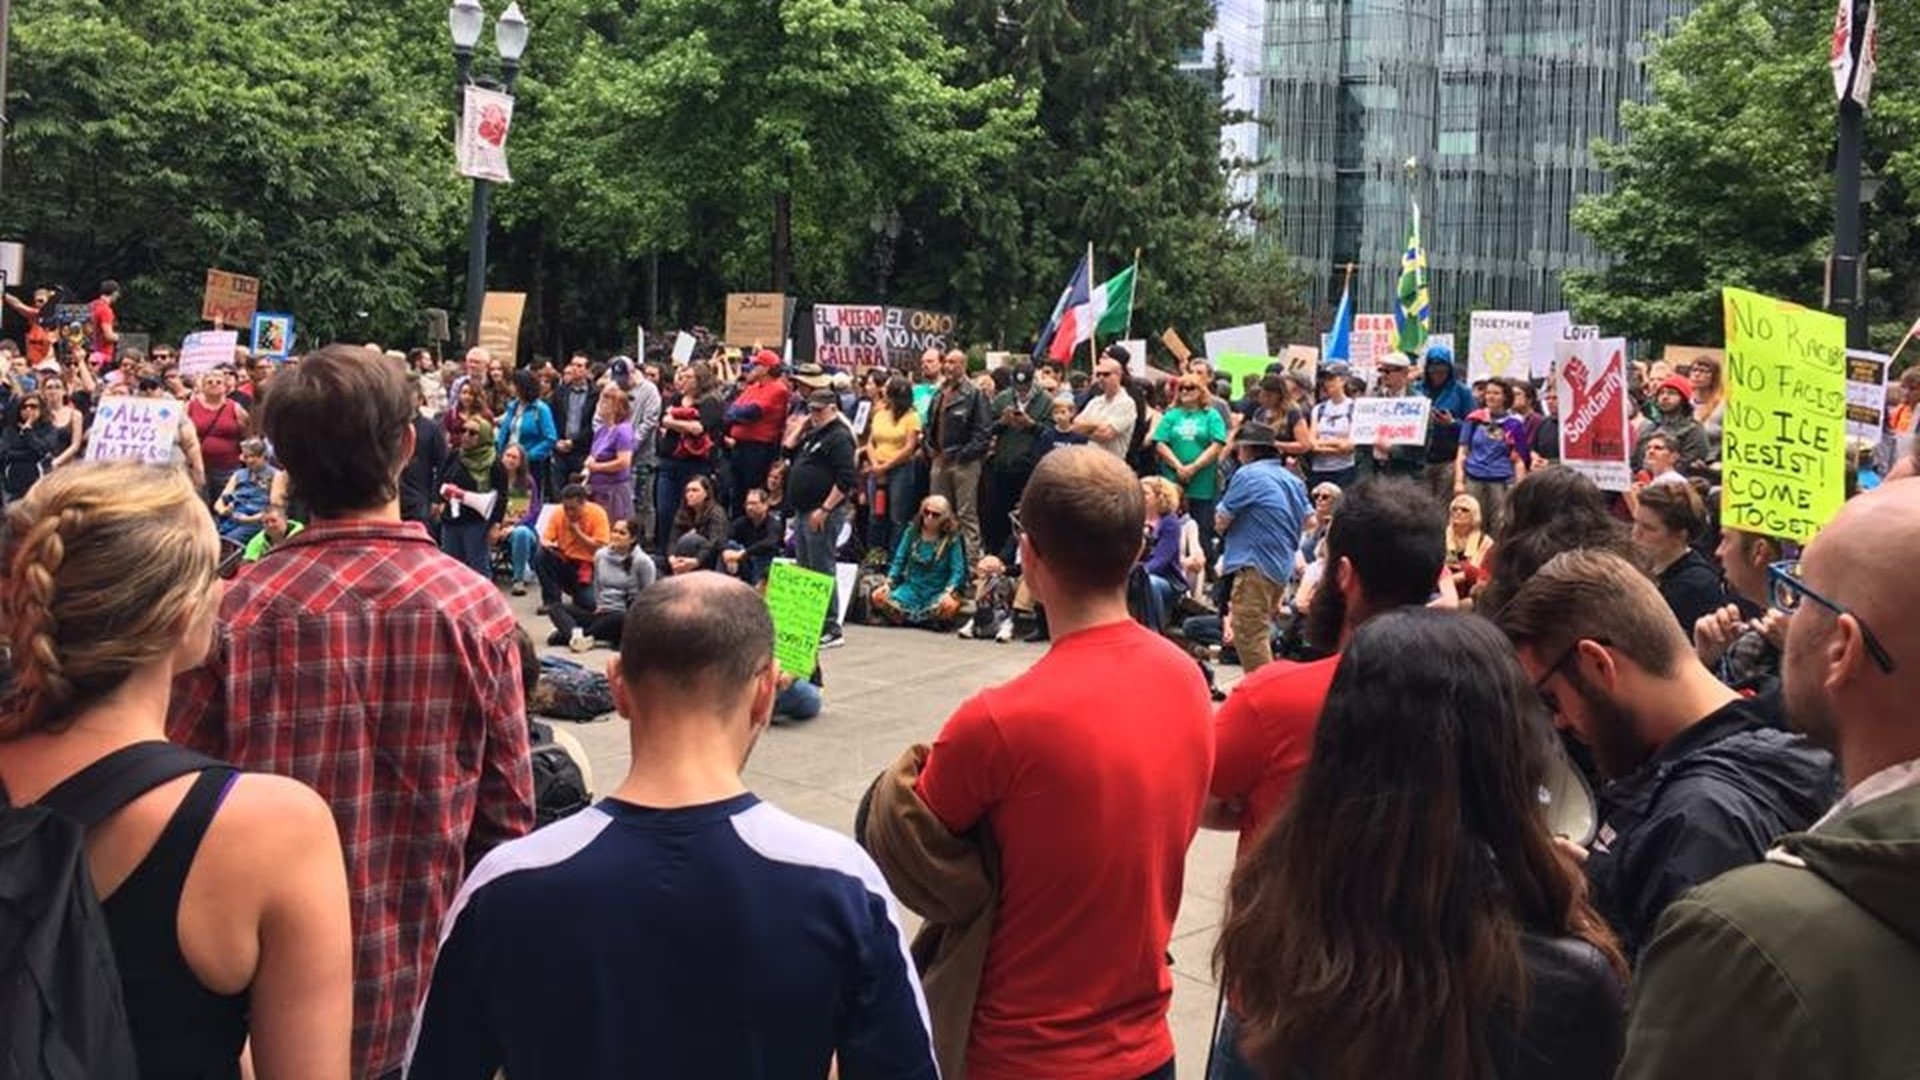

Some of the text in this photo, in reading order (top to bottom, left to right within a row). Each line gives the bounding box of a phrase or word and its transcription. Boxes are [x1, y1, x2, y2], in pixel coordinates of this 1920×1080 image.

[815, 308, 883, 326] EL MIEDO
[886, 309, 953, 333] EL ODIO
[1473, 317, 1531, 329] TOGETHER
[1729, 297, 1773, 341] NO
[823, 327, 877, 346] NO NOS
[884, 328, 948, 351] NO NOS
[1563, 326, 1597, 341] LOVE
[1729, 351, 1765, 391] NO
[112, 404, 151, 423] ALL
[1564, 367, 1624, 444] Solidarity
[1727, 400, 1765, 432] NO
[103, 423, 156, 442] LIVES
[1726, 431, 1824, 488] RESIST!
[1729, 470, 1812, 509] COME
[1730, 502, 1820, 537] TOGET
